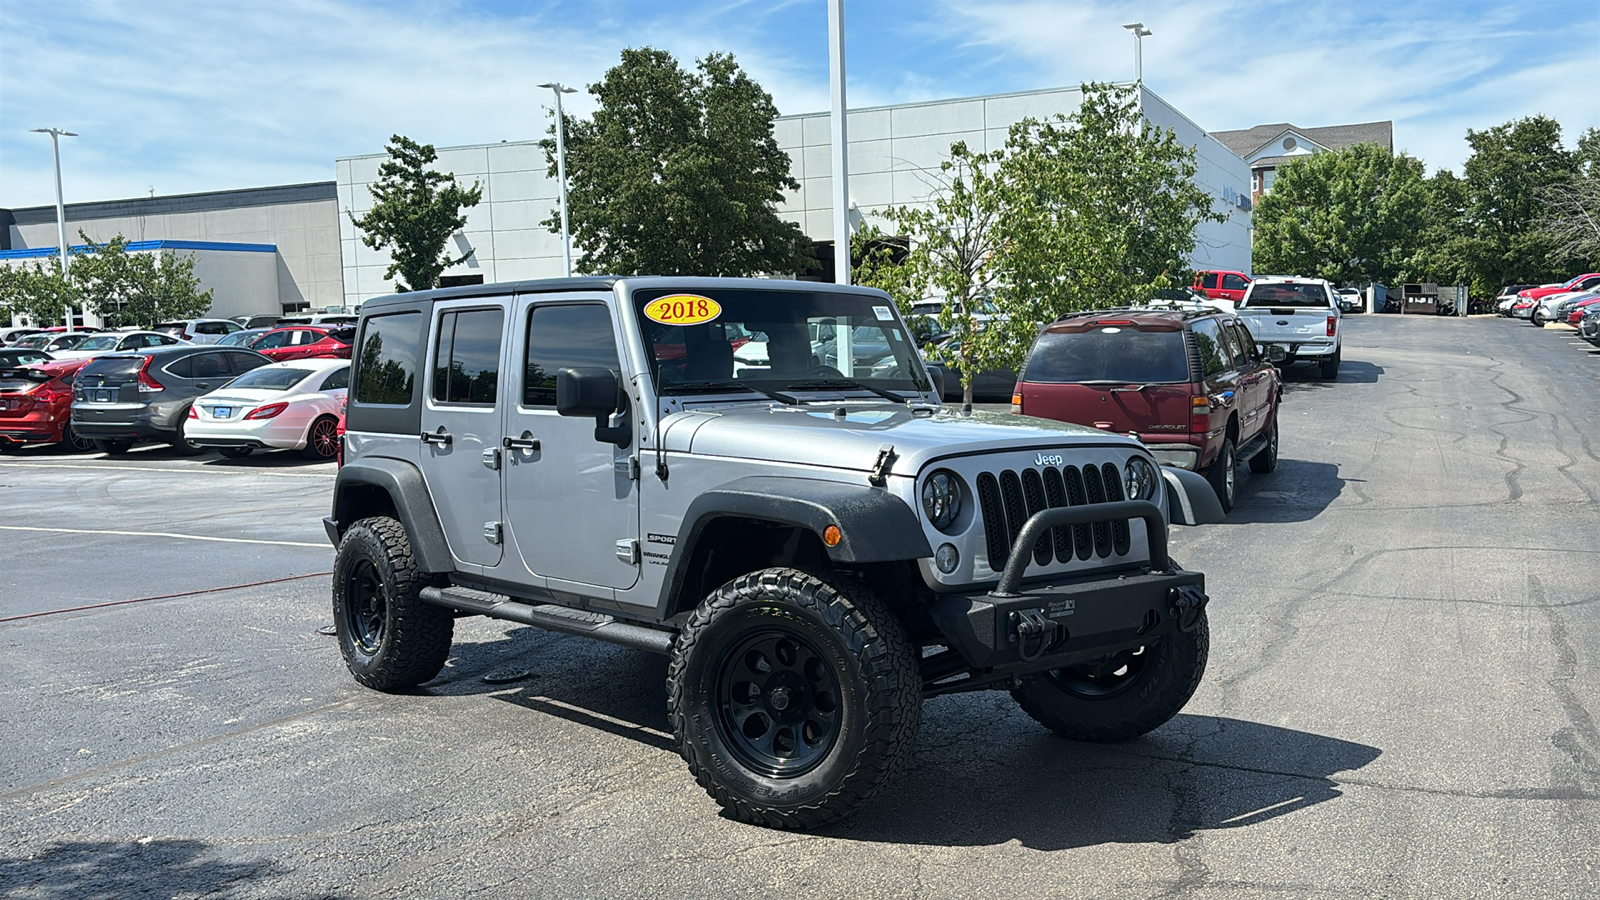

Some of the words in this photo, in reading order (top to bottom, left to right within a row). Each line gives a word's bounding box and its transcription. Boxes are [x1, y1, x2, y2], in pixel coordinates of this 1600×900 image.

[659, 299, 709, 320] 2018
[1034, 452, 1063, 467] Jeep
[648, 534, 677, 543] SPORT
[643, 552, 671, 560] WRANGL
